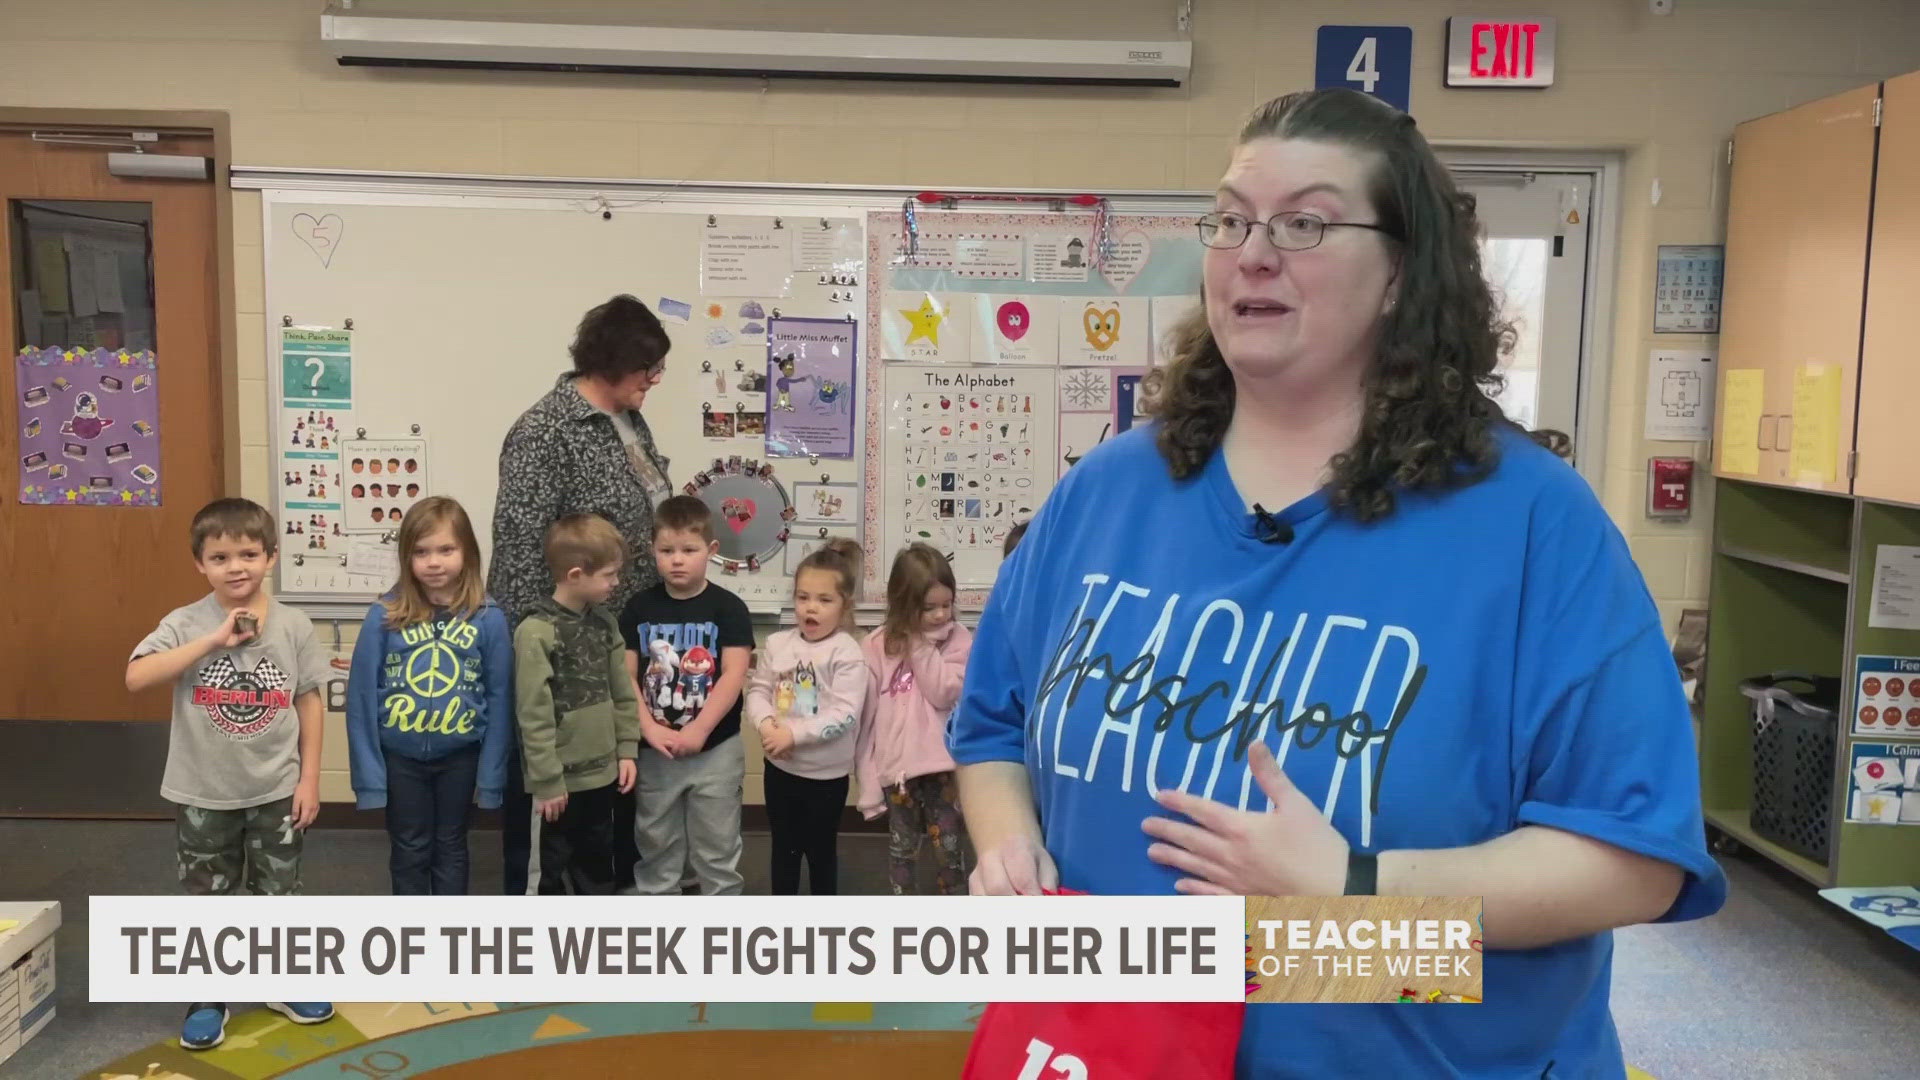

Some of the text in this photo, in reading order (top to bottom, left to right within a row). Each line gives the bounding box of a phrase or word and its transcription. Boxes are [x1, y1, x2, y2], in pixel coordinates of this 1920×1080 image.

[1471, 23, 1540, 79] EXIT
[1346, 37, 1380, 93] 4
[312, 227, 331, 248] 5
[327, 333, 350, 342] Share
[775, 333, 848, 343] Little Miss Muffet
[999, 352, 1026, 361] Balloon
[1089, 353, 1118, 361] Pretzel
[924, 372, 1016, 391] The Alphabet
[959, 394, 965, 403] B
[985, 394, 992, 403] C
[1011, 394, 1018, 403] D
[906, 420, 994, 429] E F G
[905, 446, 912, 454] H
[985, 447, 991, 456] J
[1011, 448, 1017, 456] K
[906, 473, 991, 482] L M N O
[905, 499, 1016, 508] P Q R S T
[905, 525, 994, 534] U V W
[1894, 659, 1898, 670] I
[692, 679, 700, 691] 5
[191, 685, 292, 709] BERLIN
[382, 693, 477, 734] Rule
[1030, 604, 1429, 816] preschool
[1036, 573, 1421, 848] TEACHER
[1885, 743, 1889, 755] I
